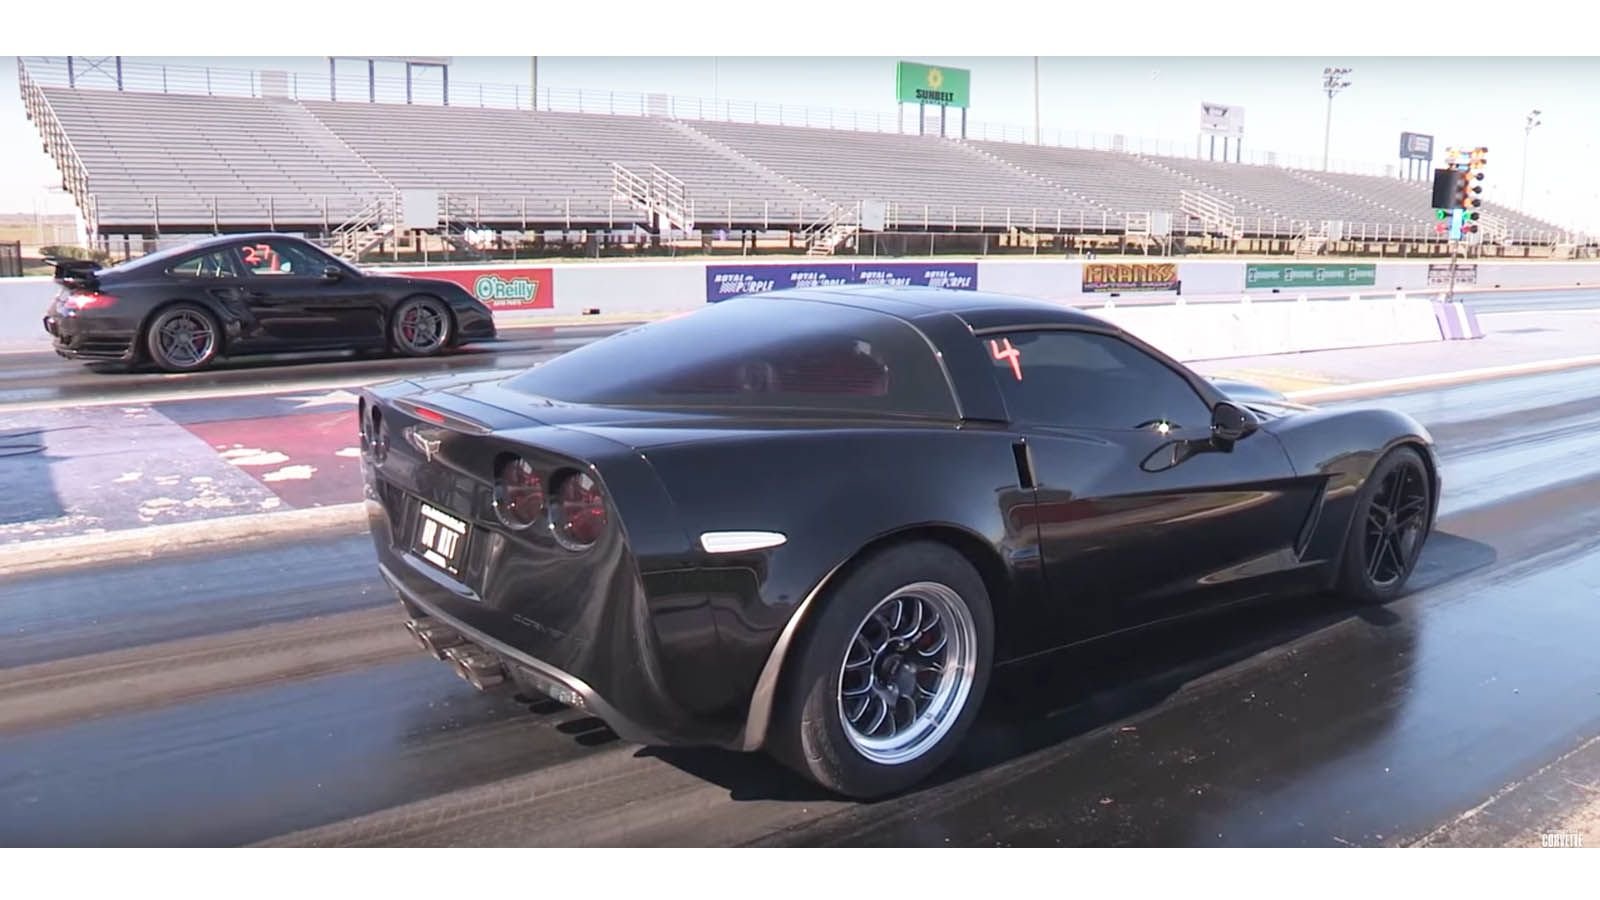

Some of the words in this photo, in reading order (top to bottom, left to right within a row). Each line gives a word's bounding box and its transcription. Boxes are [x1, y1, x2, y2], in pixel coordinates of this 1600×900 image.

[915, 88, 954, 102] SUNBELT
[242, 244, 271, 264] 27
[714, 273, 744, 282] ROYAL
[791, 272, 818, 280] ROYAL
[1086, 263, 1176, 282] FRANKS
[477, 276, 536, 300] O'Reilly
[991, 337, 1022, 381] 4
